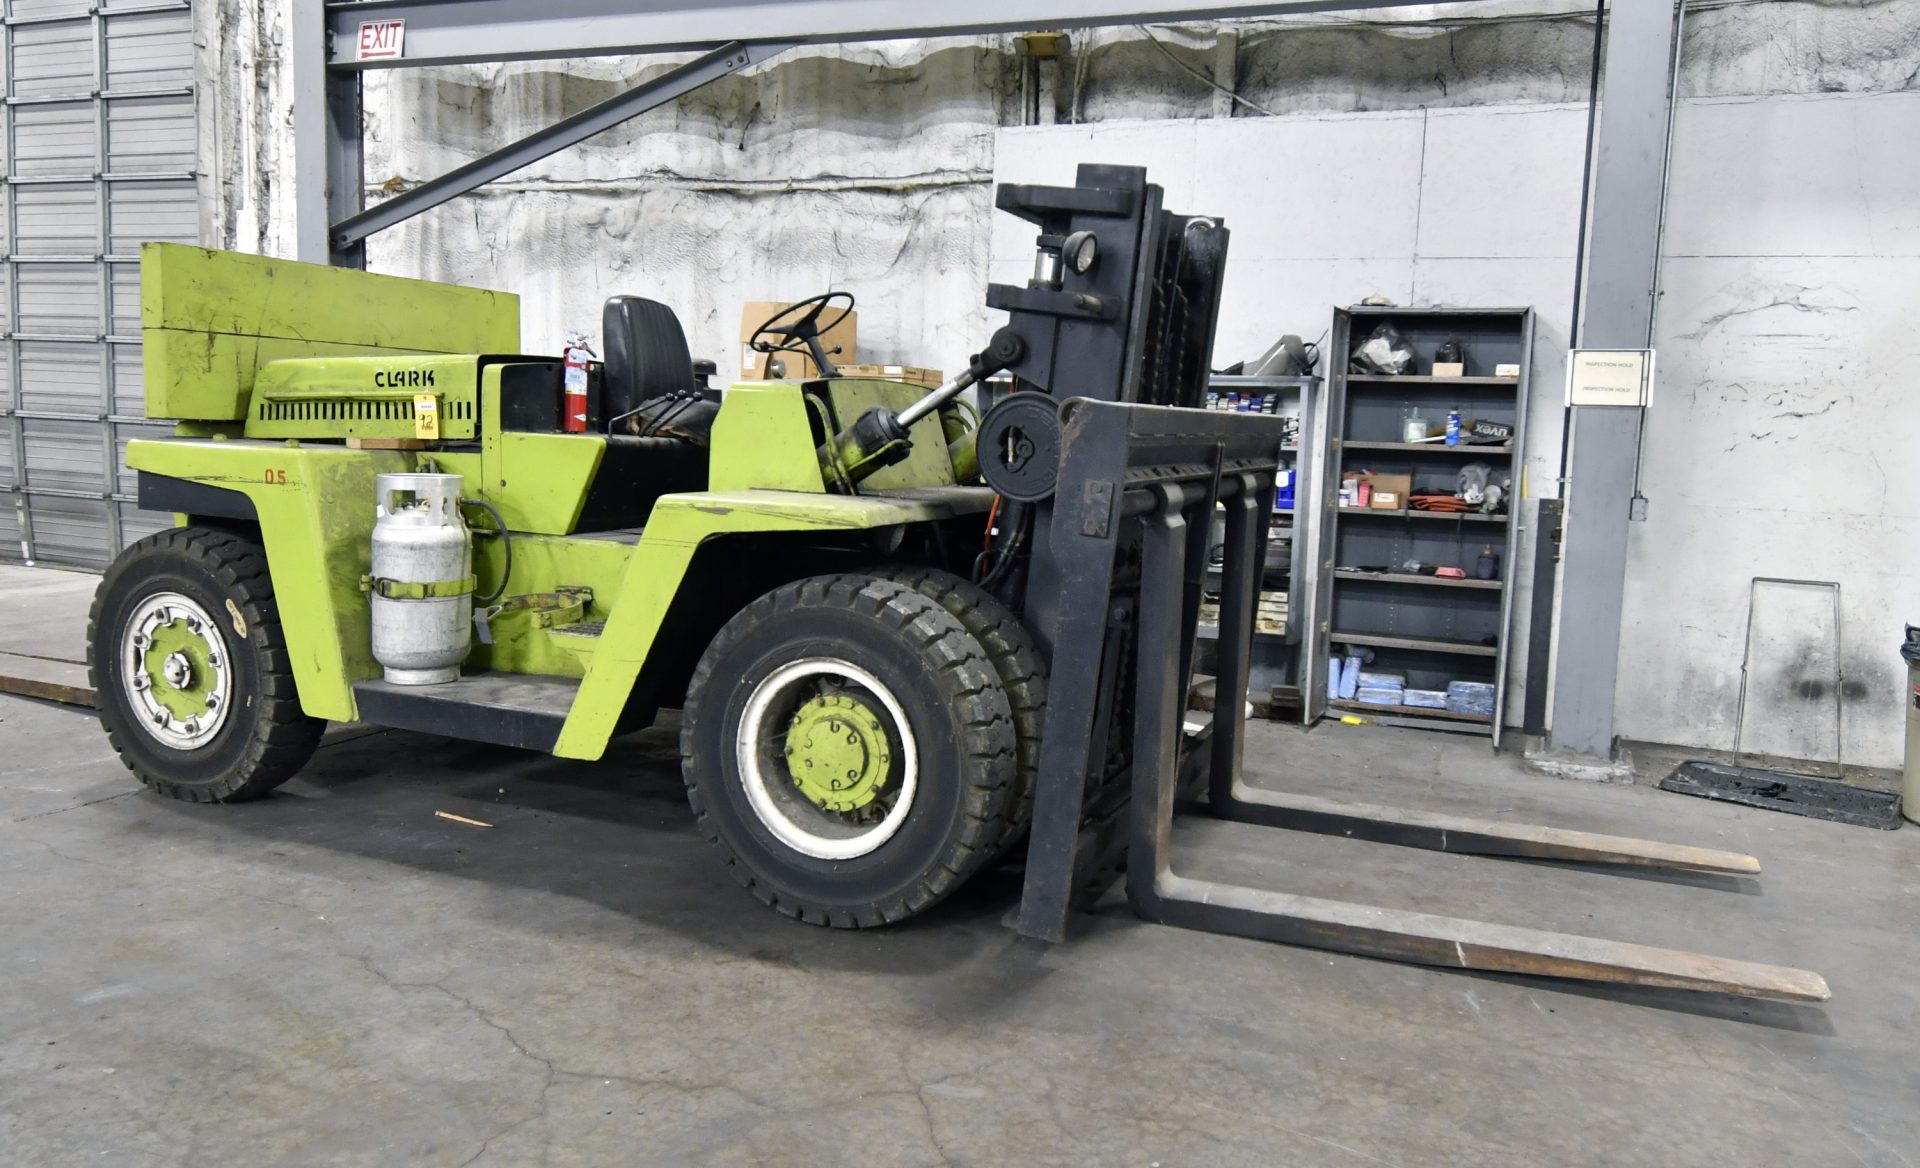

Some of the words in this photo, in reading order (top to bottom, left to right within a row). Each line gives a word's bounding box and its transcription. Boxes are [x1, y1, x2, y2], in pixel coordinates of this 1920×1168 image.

[360, 23, 402, 49] EXIT
[375, 370, 434, 387] CLARK
[1475, 424, 1508, 437] uvex
